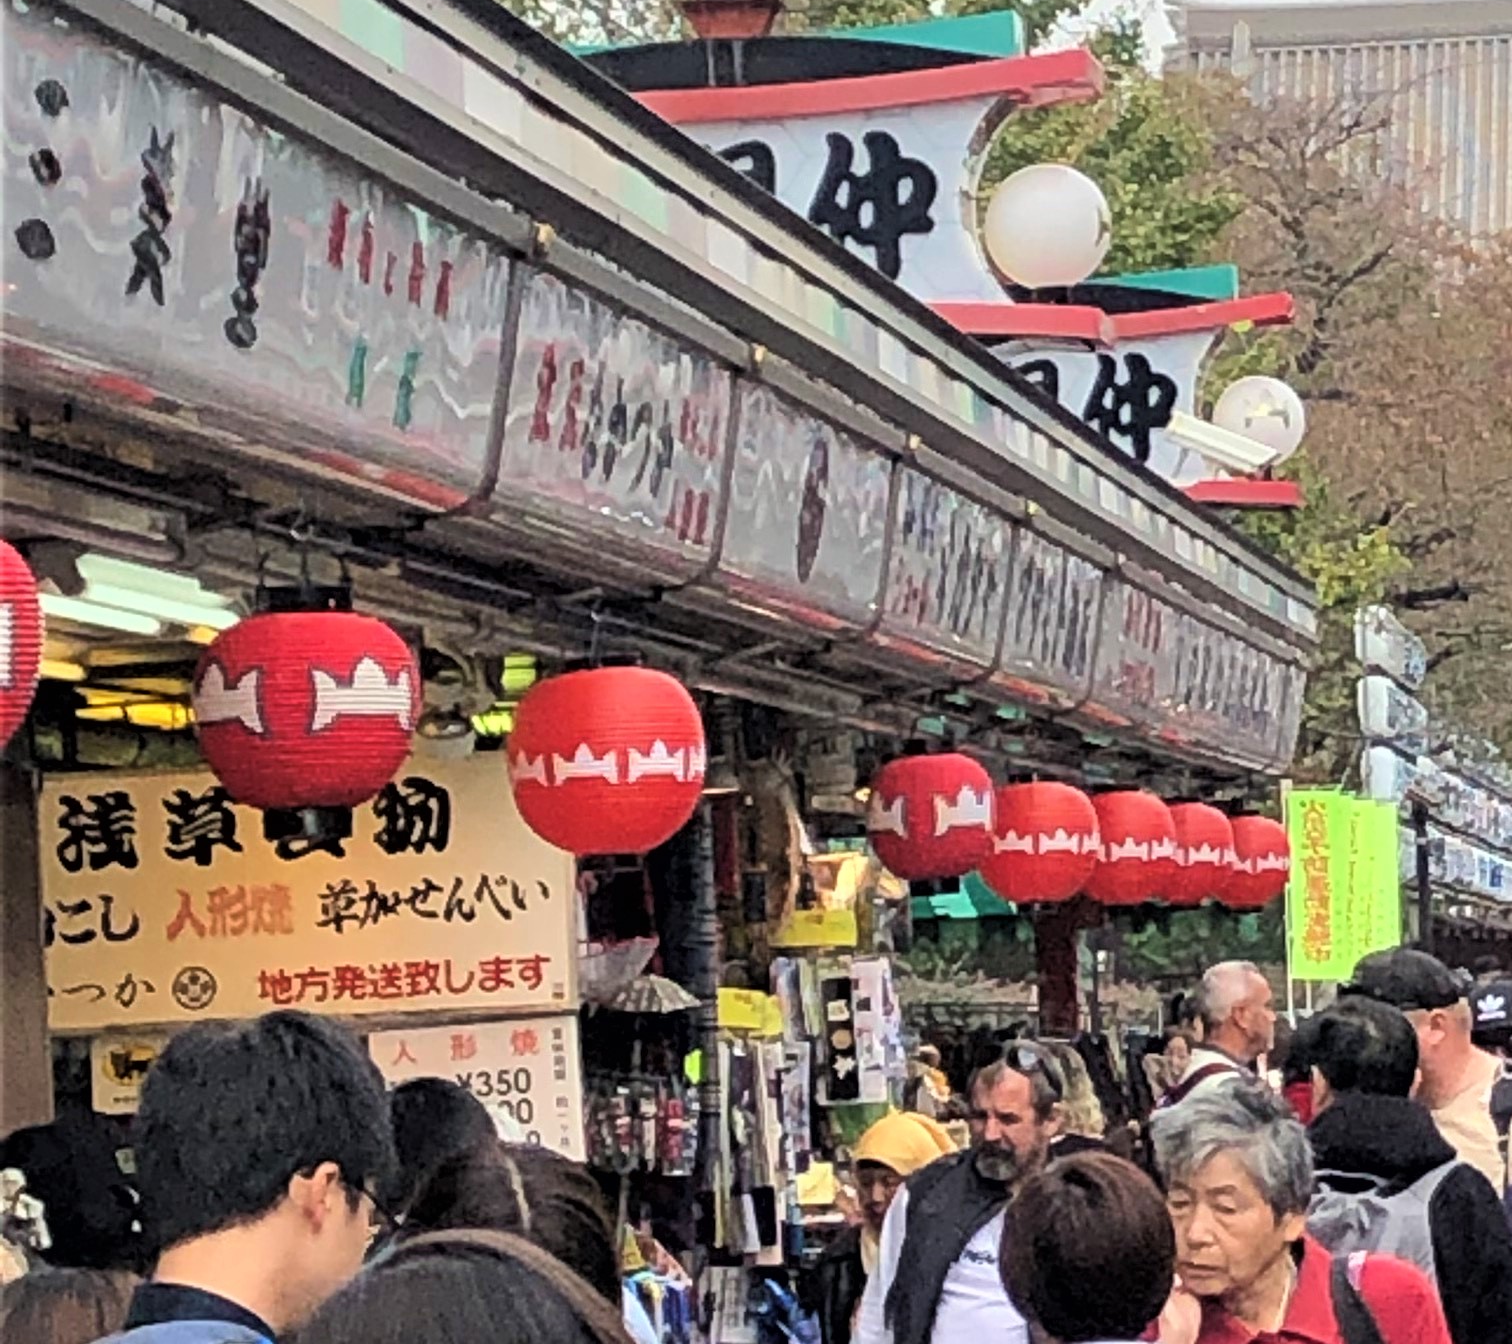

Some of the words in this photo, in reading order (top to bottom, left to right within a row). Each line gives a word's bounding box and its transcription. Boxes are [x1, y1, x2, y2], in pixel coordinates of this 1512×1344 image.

[57, 777, 451, 873] 浅草物
[43, 894, 139, 947] こし
[166, 884, 296, 943] 人形焼
[316, 873, 550, 935] 草加せんべい
[47, 972, 156, 1008] つか
[257, 954, 552, 1005] 地方発送致します
